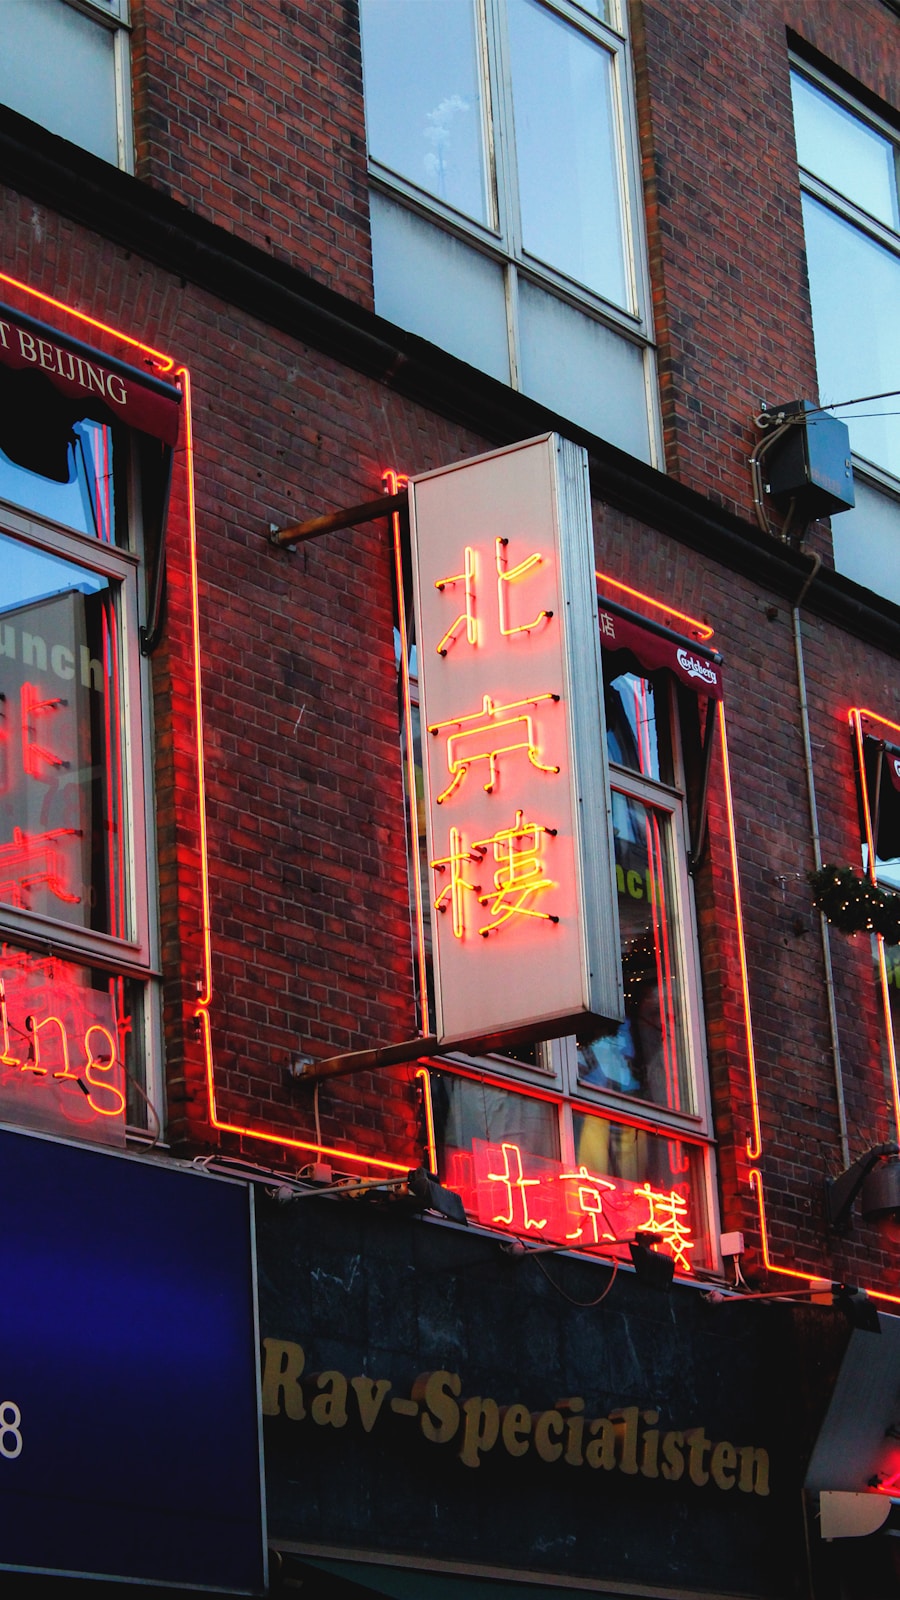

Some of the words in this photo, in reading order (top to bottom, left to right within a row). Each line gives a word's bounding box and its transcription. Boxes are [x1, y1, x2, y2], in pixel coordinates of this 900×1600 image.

[16, 328, 128, 405] BEIJING
[676, 648, 718, 685] Carlsberg
[428, 536, 561, 939] 北京樓
[0, 1400, 23, 1459] 8
[262, 1337, 771, 1498] Rav-Specialisten
